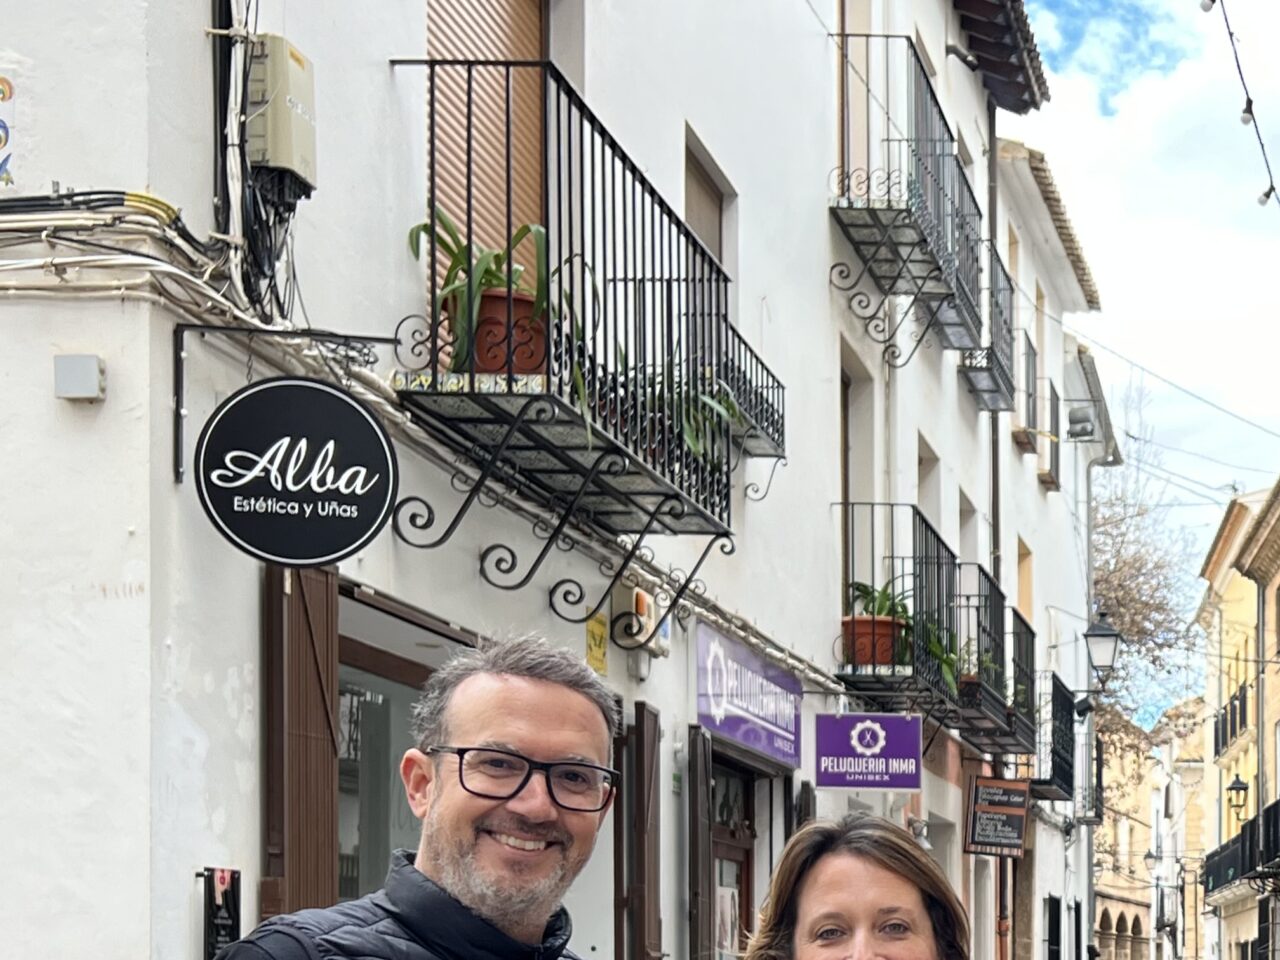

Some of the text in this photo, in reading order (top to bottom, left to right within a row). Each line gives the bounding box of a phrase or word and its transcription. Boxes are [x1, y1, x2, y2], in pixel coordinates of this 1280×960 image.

[210, 436, 380, 495] Alba
[233, 496, 358, 518] Estética y Uñas
[821, 756, 916, 774] PELUQUERIA INMA
